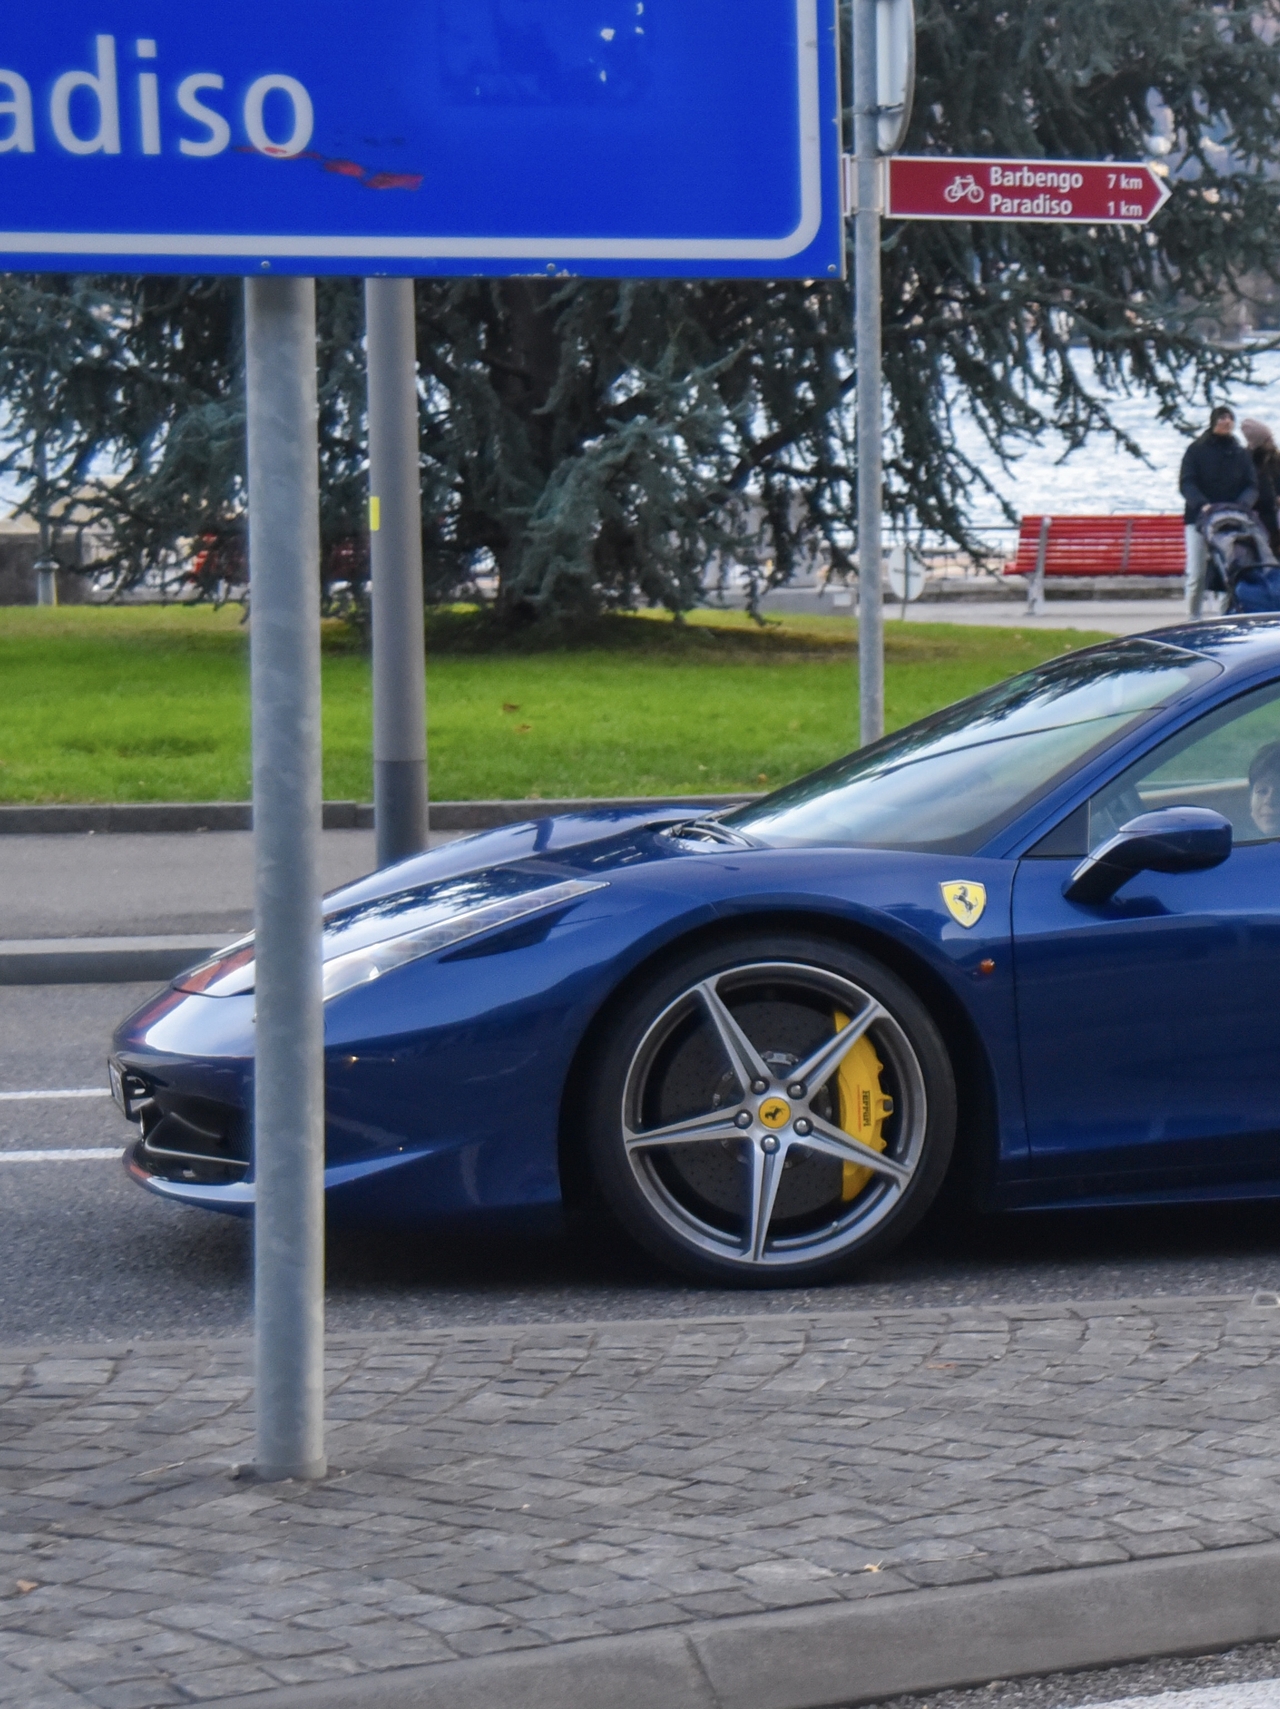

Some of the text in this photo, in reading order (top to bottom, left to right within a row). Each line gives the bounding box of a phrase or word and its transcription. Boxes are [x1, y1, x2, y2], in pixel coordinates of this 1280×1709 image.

[0, 34, 314, 158] adiso
[989, 166, 1143, 193] Barbengo 7 km
[989, 194, 1143, 217] Paradiso 1 km
